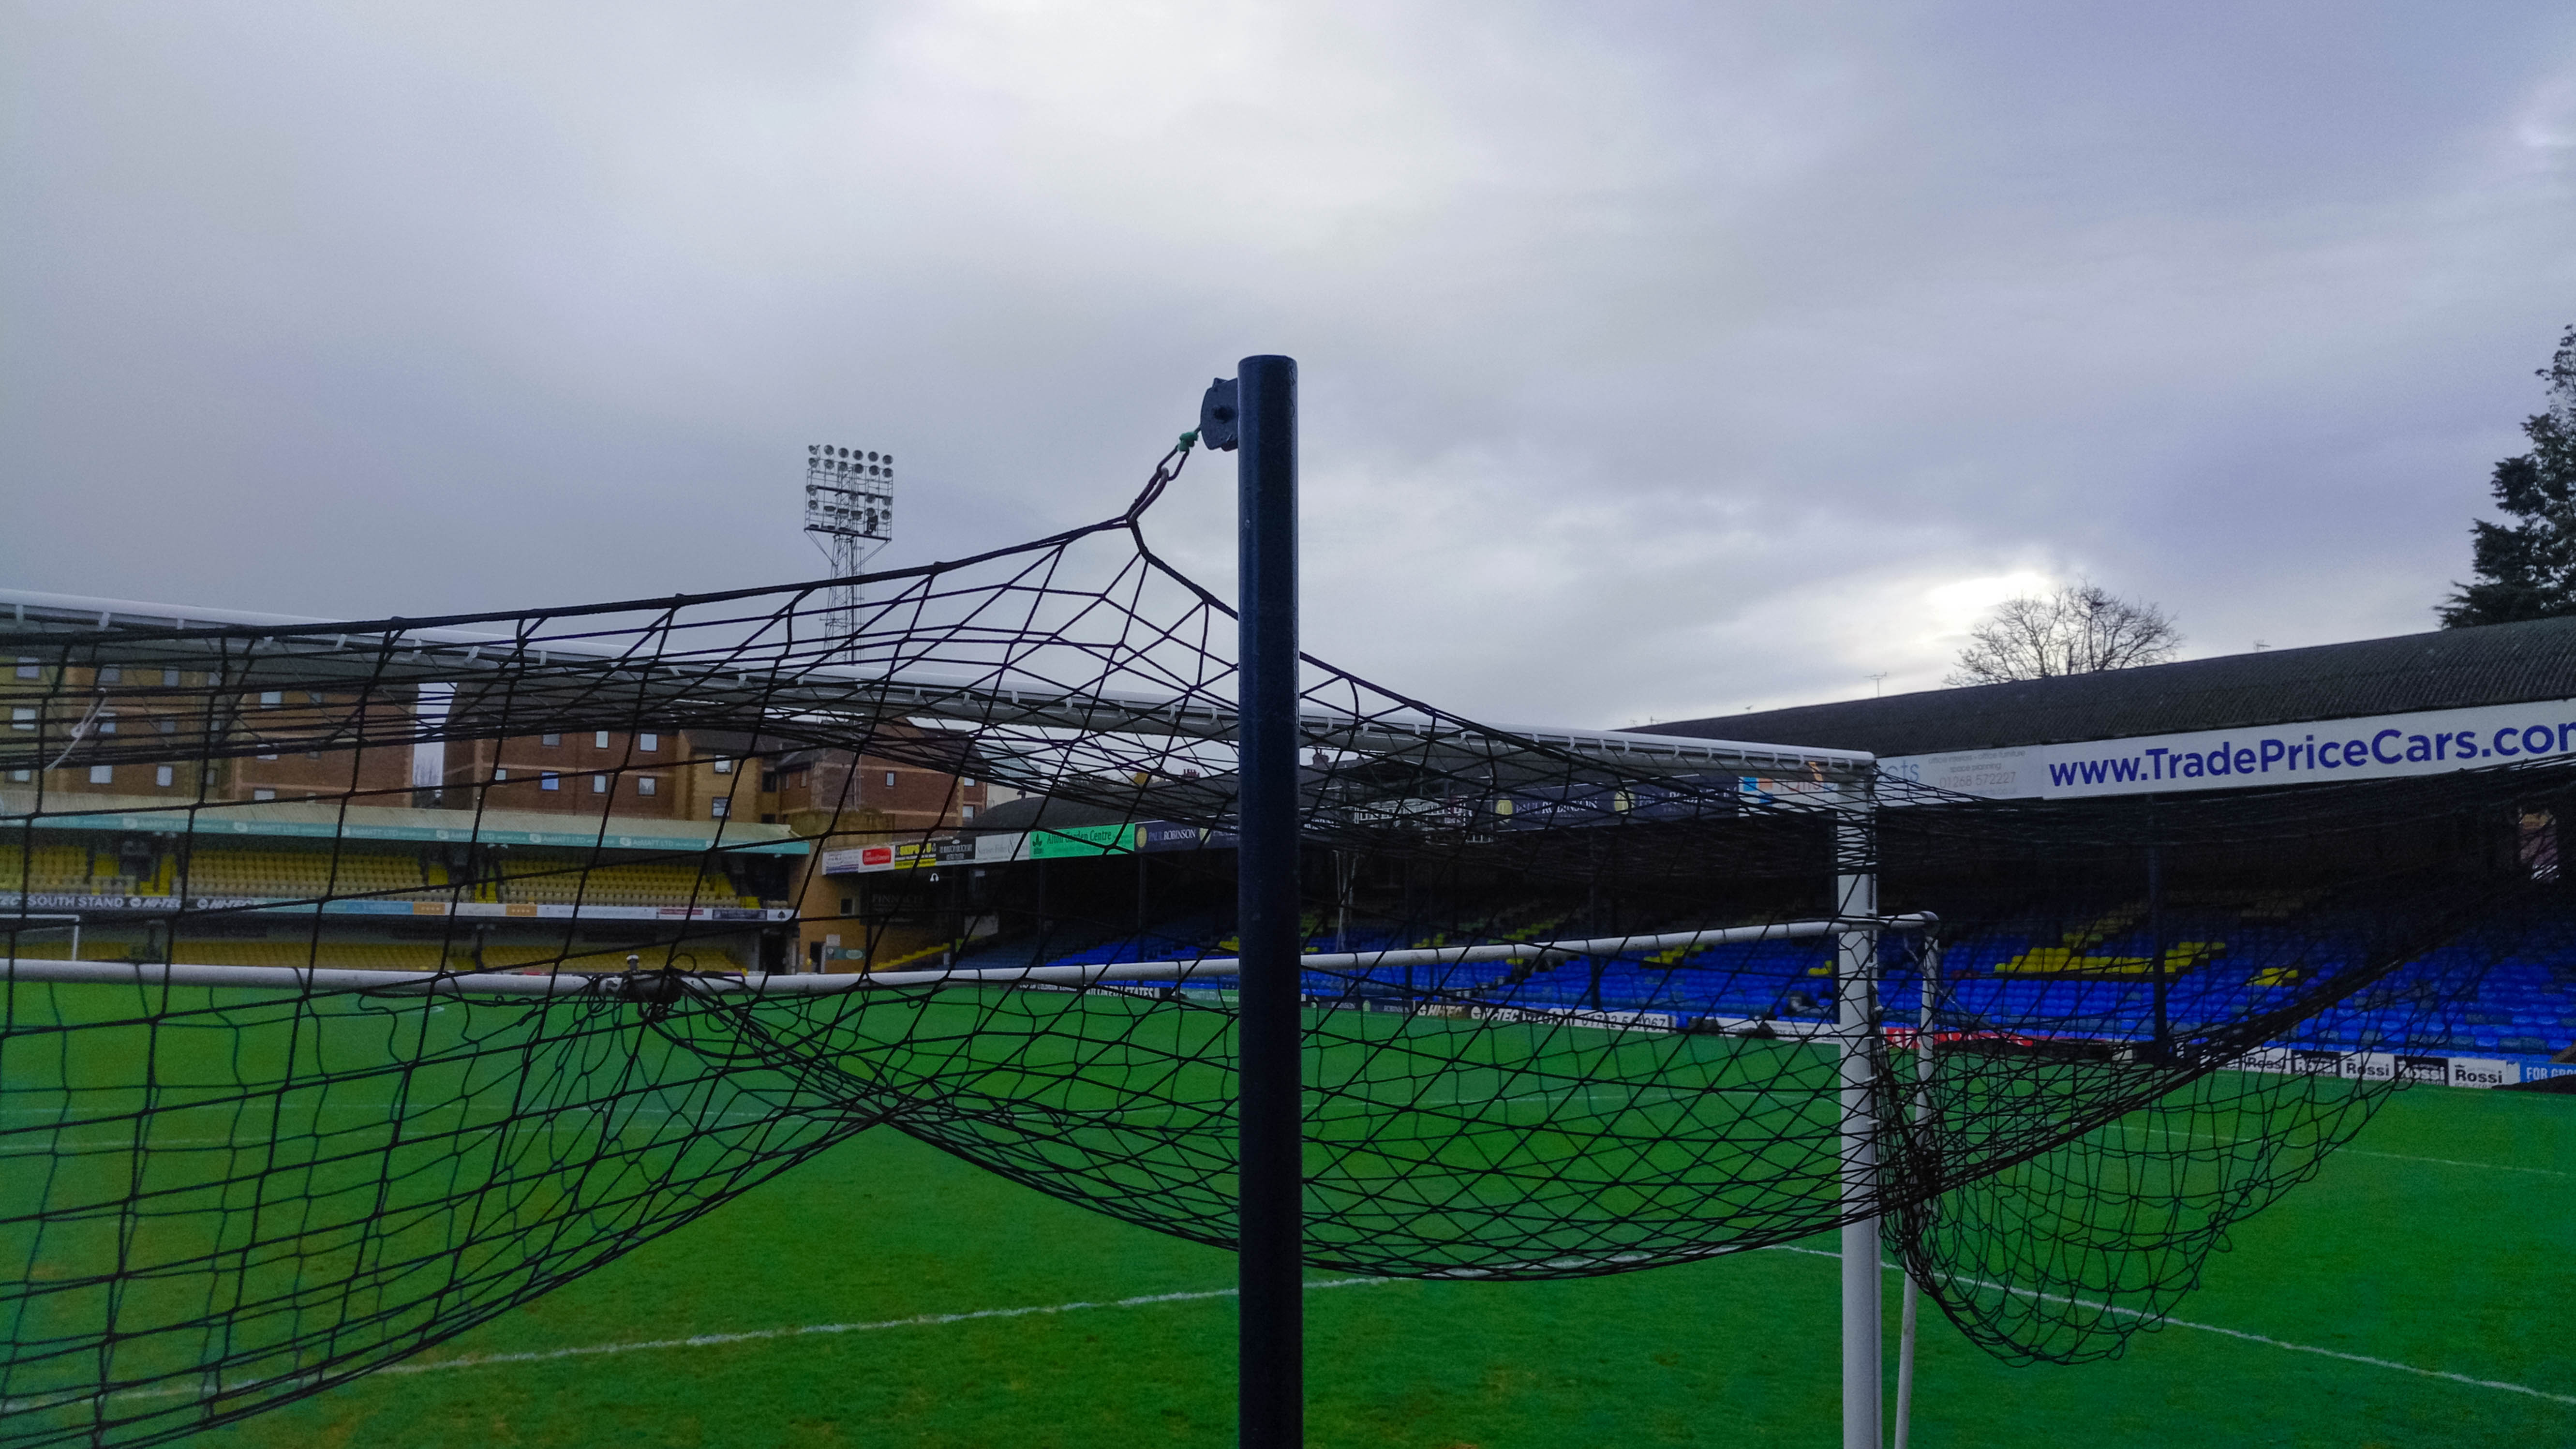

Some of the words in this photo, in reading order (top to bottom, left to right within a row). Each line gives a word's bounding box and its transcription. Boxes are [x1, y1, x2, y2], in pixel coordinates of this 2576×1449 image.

[1939, 776, 1972, 788] 01268
[1976, 772, 2016, 785] 572227
[1090, 829, 1112, 841] Centre
[1164, 829, 1196, 840] ROBINSON
[28, 896, 75, 907] SOUTH
[78, 897, 124, 908] STAND
[1482, 1007, 1519, 1022] H-TEC
[2346, 1063, 2390, 1076] Rossi
[2456, 1069, 2502, 1083] Rossi
[2526, 1067, 2548, 1080] FOR
